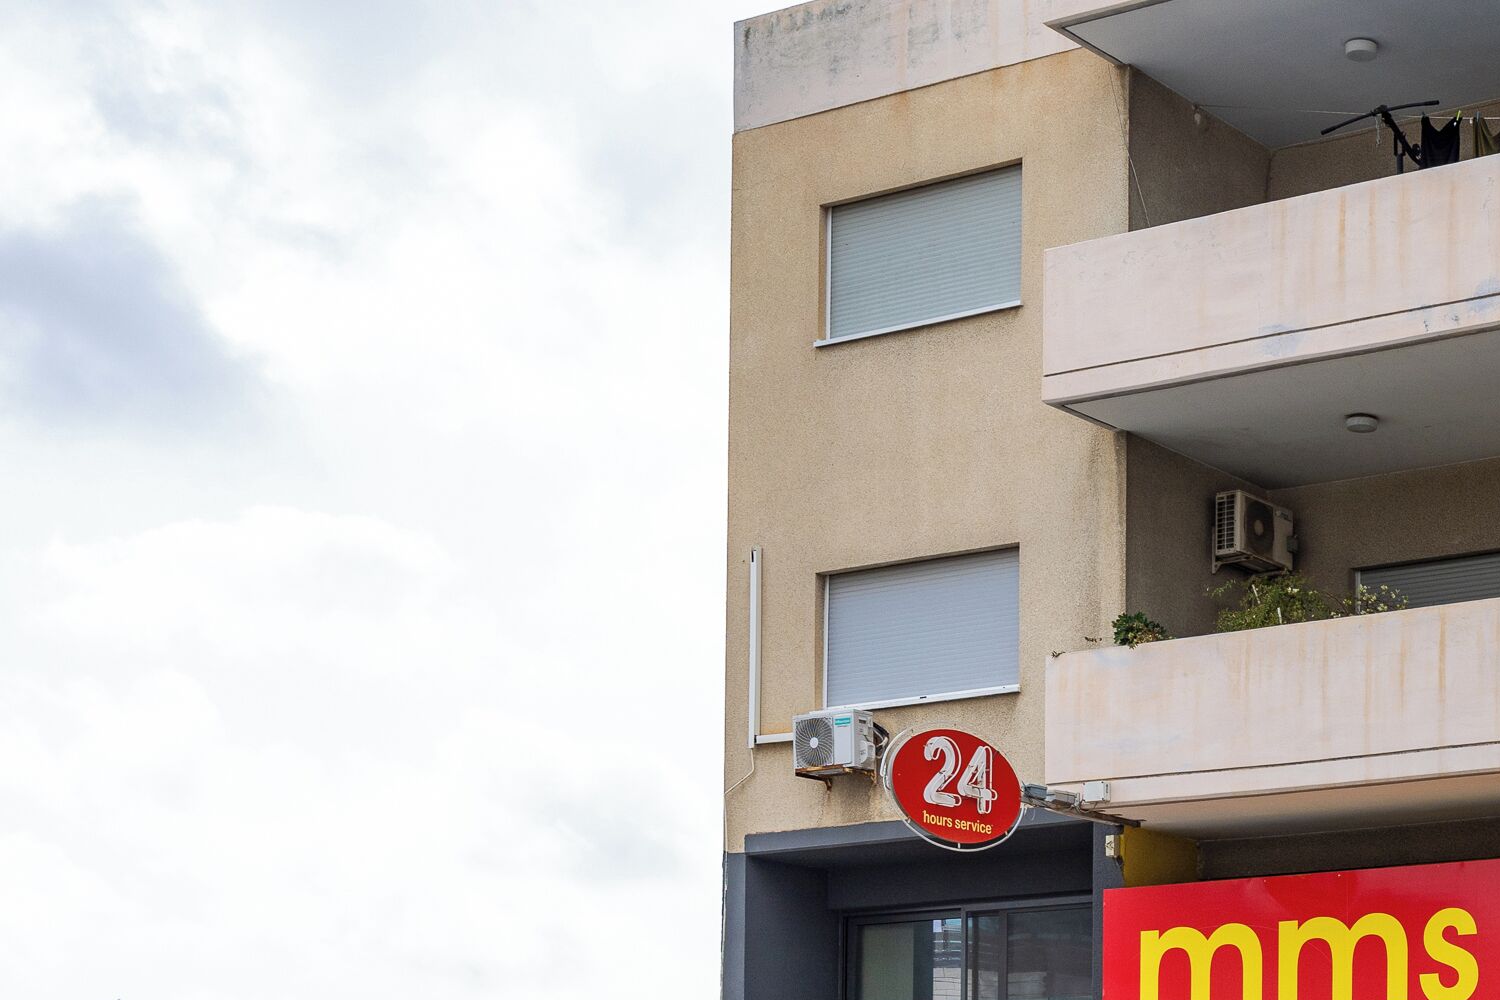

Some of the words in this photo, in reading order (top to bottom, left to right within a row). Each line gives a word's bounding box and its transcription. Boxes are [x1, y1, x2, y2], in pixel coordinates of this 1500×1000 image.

[923, 736, 998, 814] 24
[923, 810, 952, 828] hours
[955, 819, 992, 835] service
